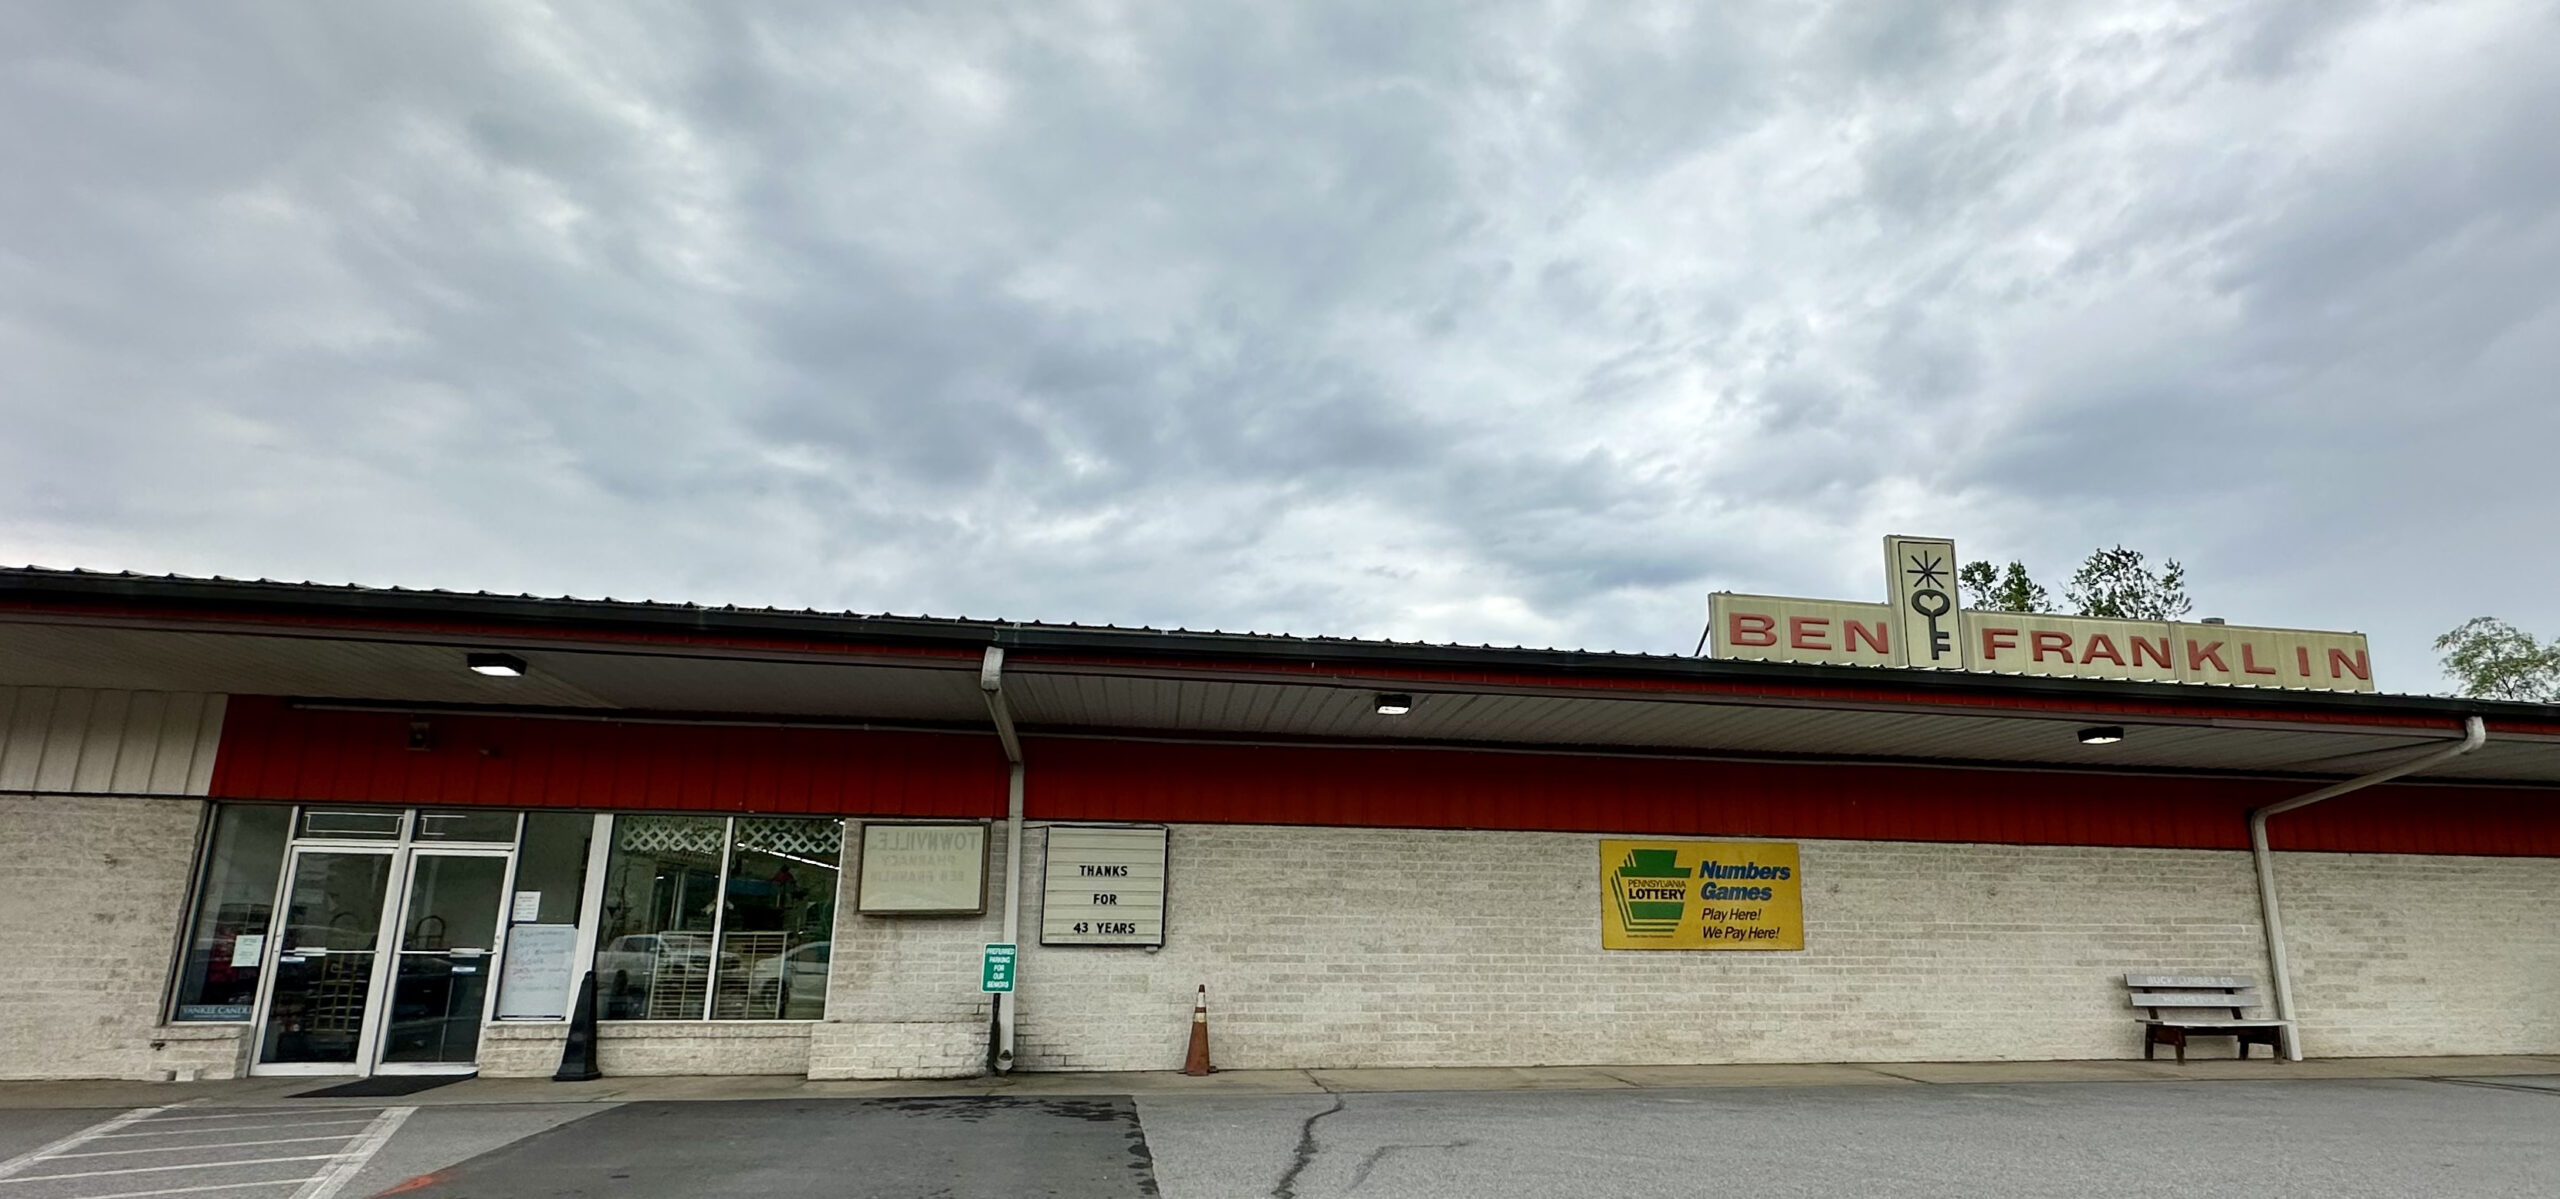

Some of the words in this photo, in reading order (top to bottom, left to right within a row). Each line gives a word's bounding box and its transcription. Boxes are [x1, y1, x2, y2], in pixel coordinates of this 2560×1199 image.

[1728, 612, 1890, 654] BEN
[1982, 627, 2370, 681] FRANKLIN
[1079, 865, 1128, 877] THANKS
[1699, 861, 1791, 881] Numbers
[1628, 879, 1687, 888] PENNSYLVANIA
[1628, 888, 1687, 900] LOTTERY
[1700, 882, 1773, 901] Games
[1093, 893, 1117, 905] FOR
[1702, 908, 1727, 923] Play
[1729, 908, 1761, 921] Here!
[1073, 922, 1088, 934] 43
[1097, 922, 1135, 934] YEARS
[1703, 927, 1722, 939] We
[1724, 927, 1746, 942] Pay
[1748, 927, 1780, 939] Here!
[993, 972, 1005, 980] OUR
